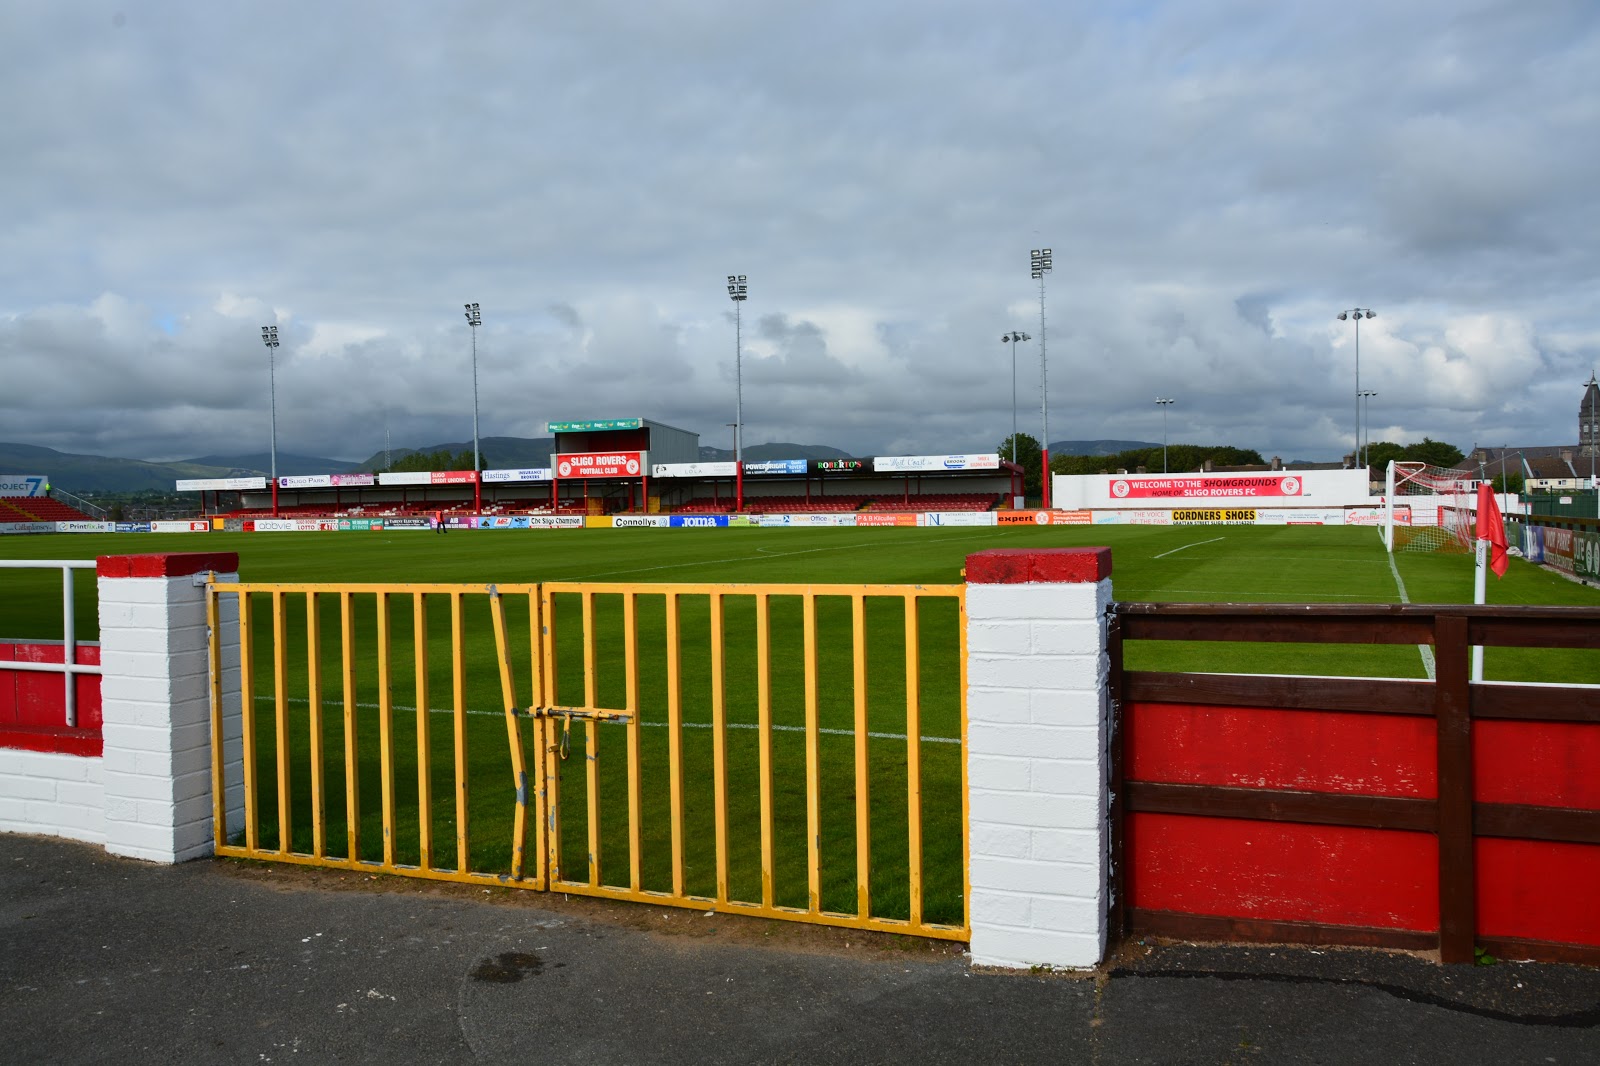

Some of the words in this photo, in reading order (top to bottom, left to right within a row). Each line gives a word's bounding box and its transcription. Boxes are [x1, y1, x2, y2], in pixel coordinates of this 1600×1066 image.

[571, 457, 593, 466] SLIGO
[596, 456, 626, 465] ROVERS
[818, 461, 862, 469] ROBERTO'S
[484, 472, 511, 480] Hastings
[25, 478, 43, 497] 7
[1132, 480, 1172, 489] WELCOME
[1186, 480, 1202, 488] THE
[1203, 478, 1278, 488] SHOWGROUNDS
[1184, 488, 1209, 497] SLIGO
[1211, 488, 1244, 496] ROVERS
[1245, 487, 1256, 496] FC
[1173, 511, 1221, 520] CORDNERS
[1225, 510, 1255, 520] SHOES
[258, 521, 292, 530] abbvie
[542, 517, 554, 525] Sligo
[555, 517, 580, 526] Champion
[615, 517, 657, 527] Connollys
